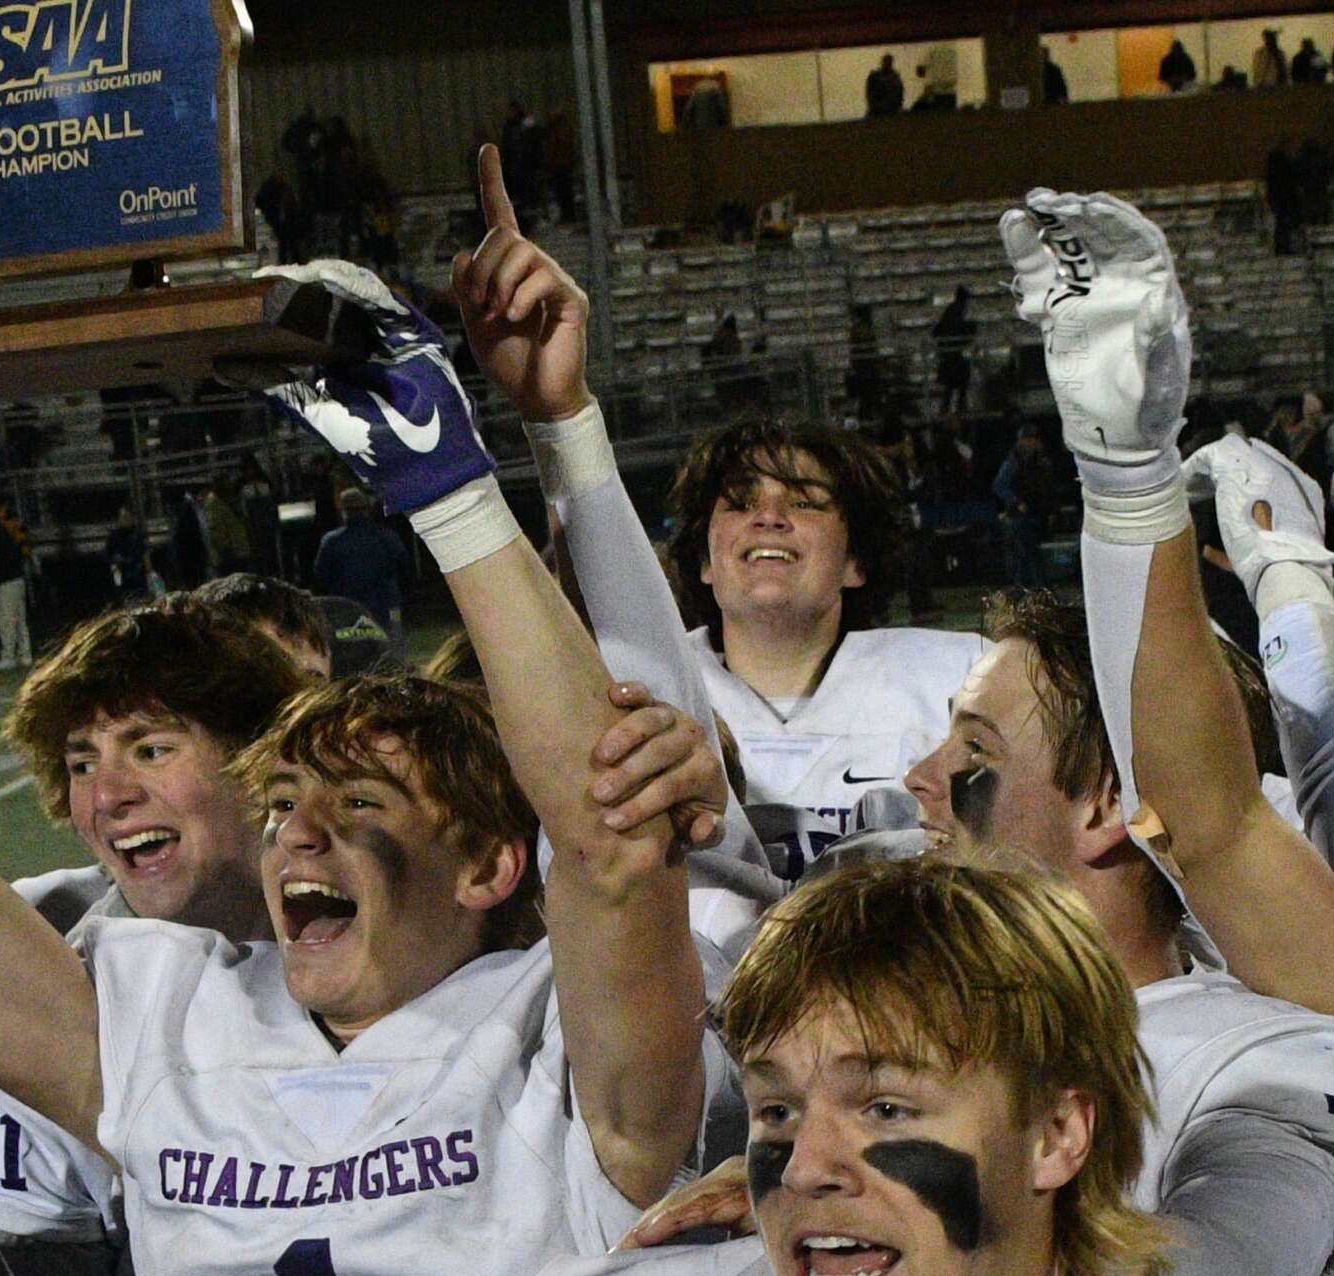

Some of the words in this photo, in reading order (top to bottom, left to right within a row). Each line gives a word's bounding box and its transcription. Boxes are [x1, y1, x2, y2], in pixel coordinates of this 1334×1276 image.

[5, 81, 74, 106] ACTIVITIES
[77, 69, 163, 94] ASSOCIATION
[119, 183, 197, 214] OnPoint
[159, 1130, 479, 1209] CHALLENGERS
